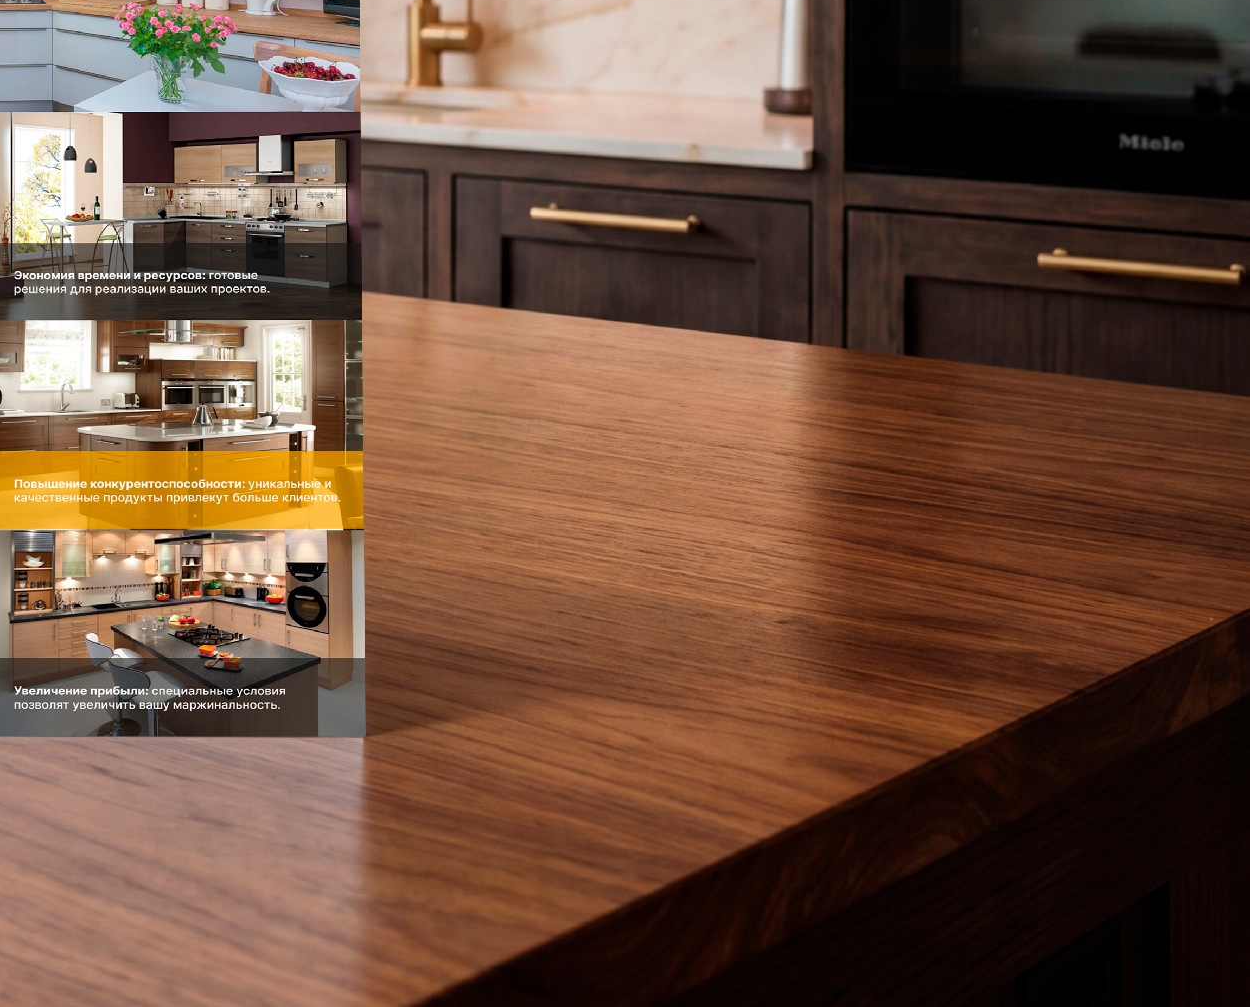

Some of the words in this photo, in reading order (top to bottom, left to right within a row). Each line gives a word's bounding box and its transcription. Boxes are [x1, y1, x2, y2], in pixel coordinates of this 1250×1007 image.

[1118, 133, 1185, 152] Miele
[14, 270, 75, 280] Экономия
[77, 272, 131, 280] времени
[133, 272, 141, 280] и
[143, 272, 206, 283] ресурсов:
[208, 272, 259, 280] готовые
[14, 285, 67, 296] решения
[69, 285, 92, 296] для
[95, 285, 166, 296] реализации
[169, 285, 208, 294] ваших
[211, 285, 270, 296] проектов.
[14, 479, 88, 489] Повышение
[90, 478, 246, 491] конкурентоспособности:
[248, 480, 322, 491] уникальные
[324, 480, 332, 489] и
[14, 494, 100, 503] качественные
[103, 494, 163, 505] продукты
[166, 494, 230, 505] привлекут
[232, 492, 279, 503] больше
[282, 494, 341, 503] клиентов.
[14, 685, 88, 696] Увеличение
[90, 685, 149, 698] прибыли:
[151, 688, 234, 698] специальные
[236, 688, 286, 698] условия
[14, 701, 70, 710] позволят
[72, 701, 136, 712] увеличить
[139, 701, 170, 712] вашу
[173, 701, 281, 712] маржинальность.
